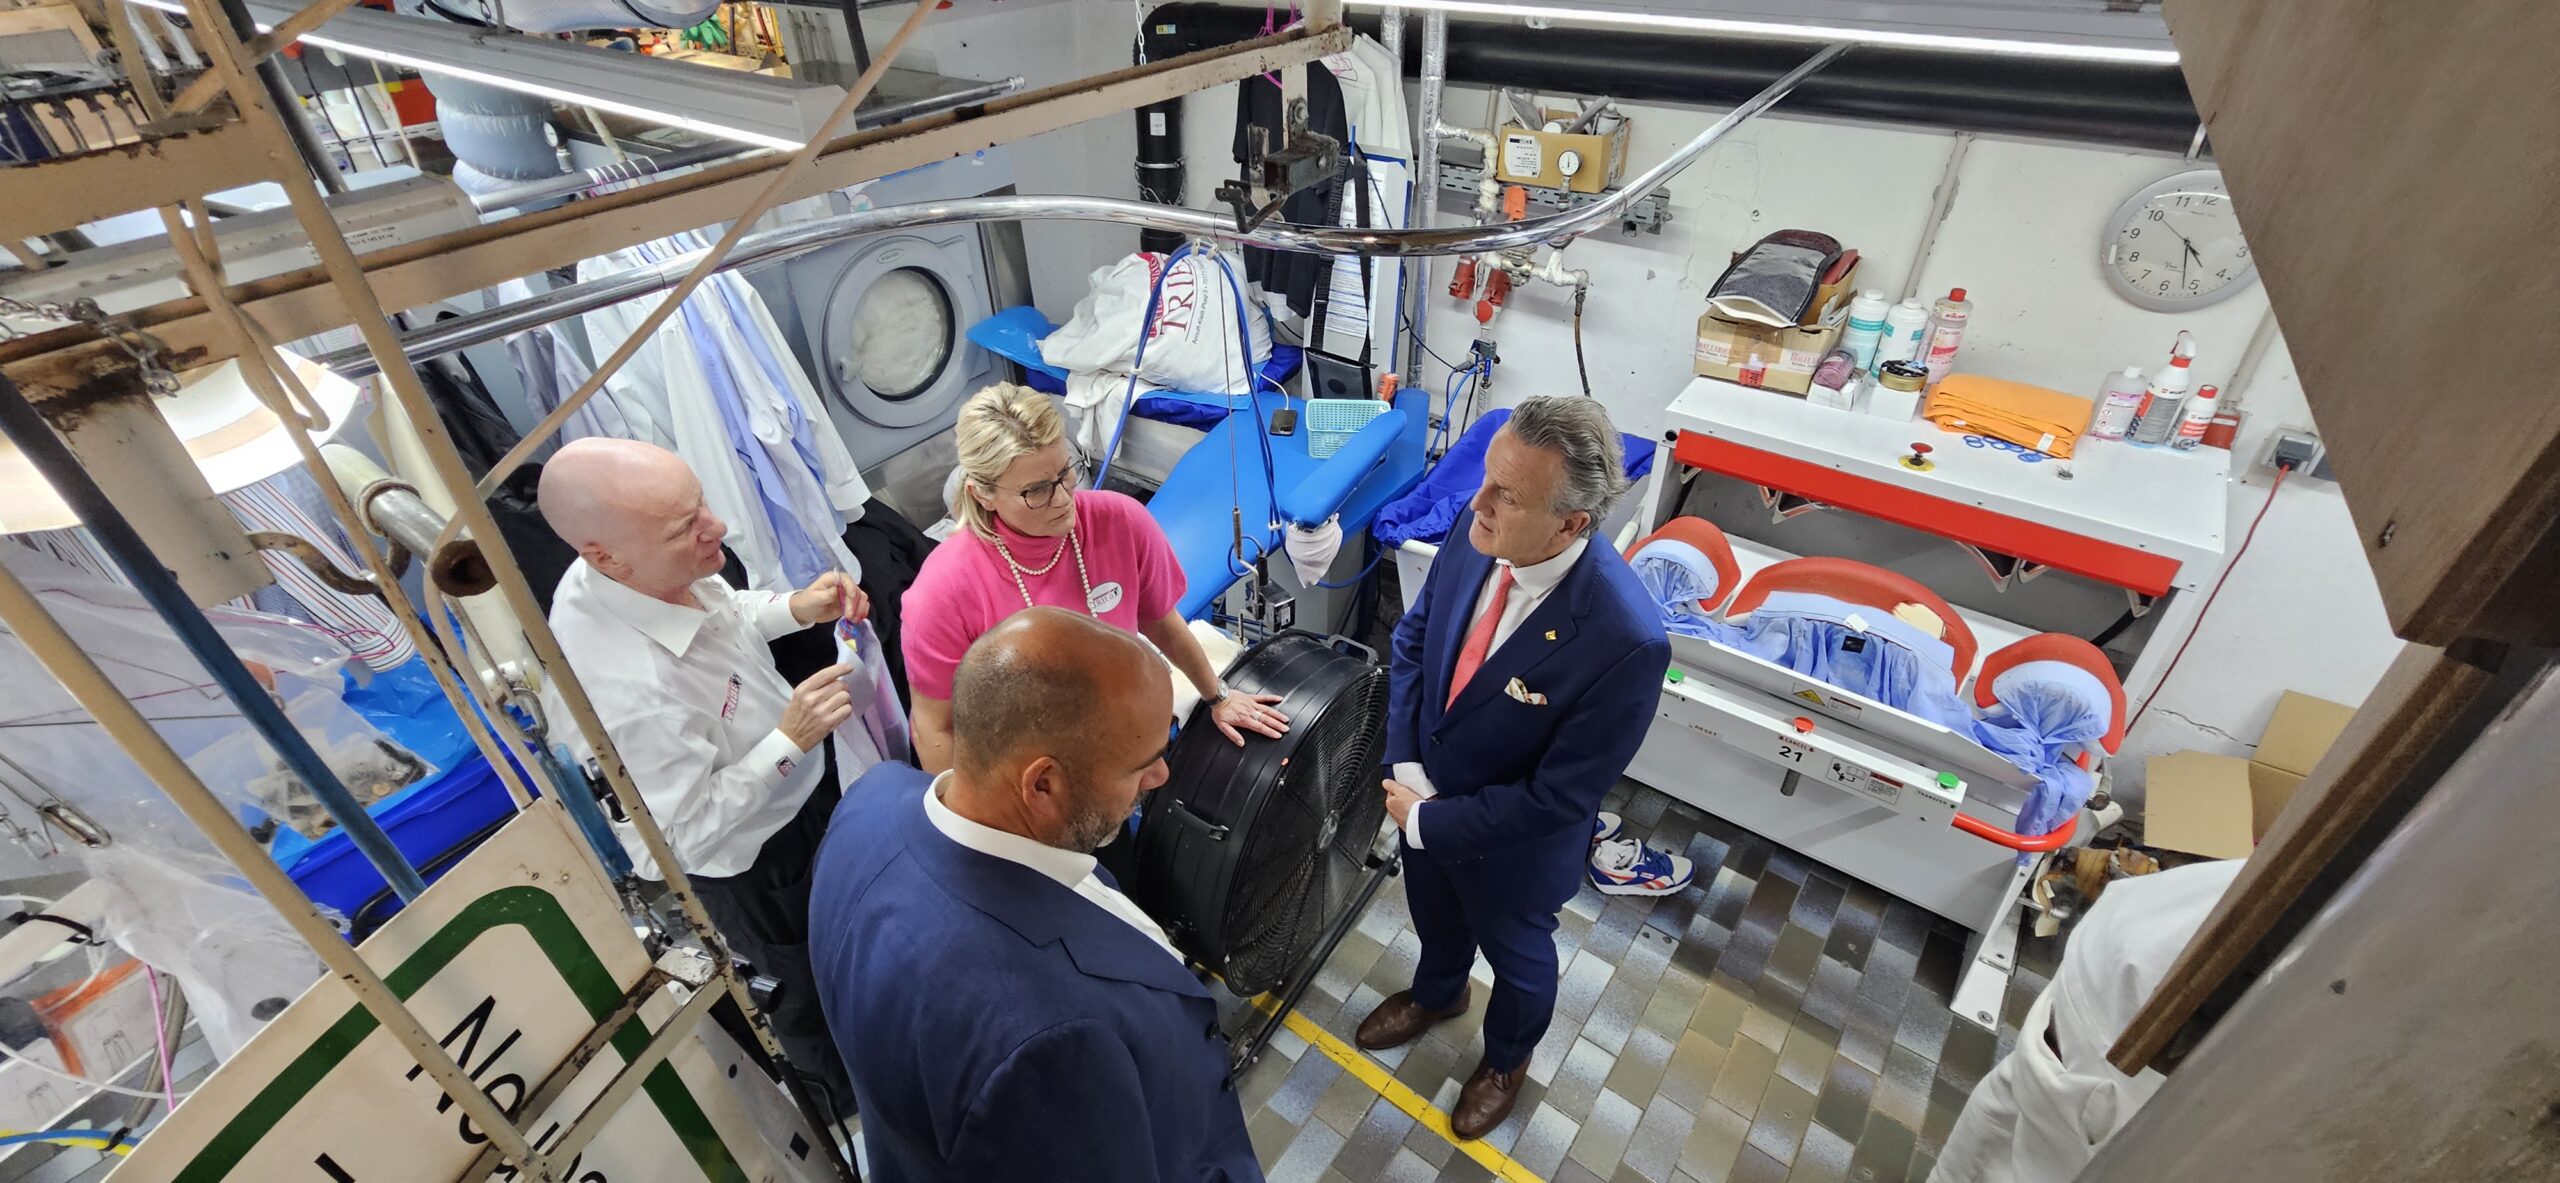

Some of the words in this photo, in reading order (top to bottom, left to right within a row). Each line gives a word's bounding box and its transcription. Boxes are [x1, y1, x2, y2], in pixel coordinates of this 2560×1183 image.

[2176, 195, 2191, 208] 11
[2148, 209, 2165, 222] 10
[2129, 228, 2141, 239] 9
[2129, 251, 2140, 263] 8
[2236, 246, 2249, 258] 3
[2141, 268, 2152, 280] 7
[2215, 268, 2227, 278] 4
[2159, 280, 2171, 291] 6
[2188, 279, 2200, 290] 5
[1694, 725, 1717, 737] RESET
[1784, 738, 1808, 750] CANCEL
[1779, 745, 1803, 763] 21
